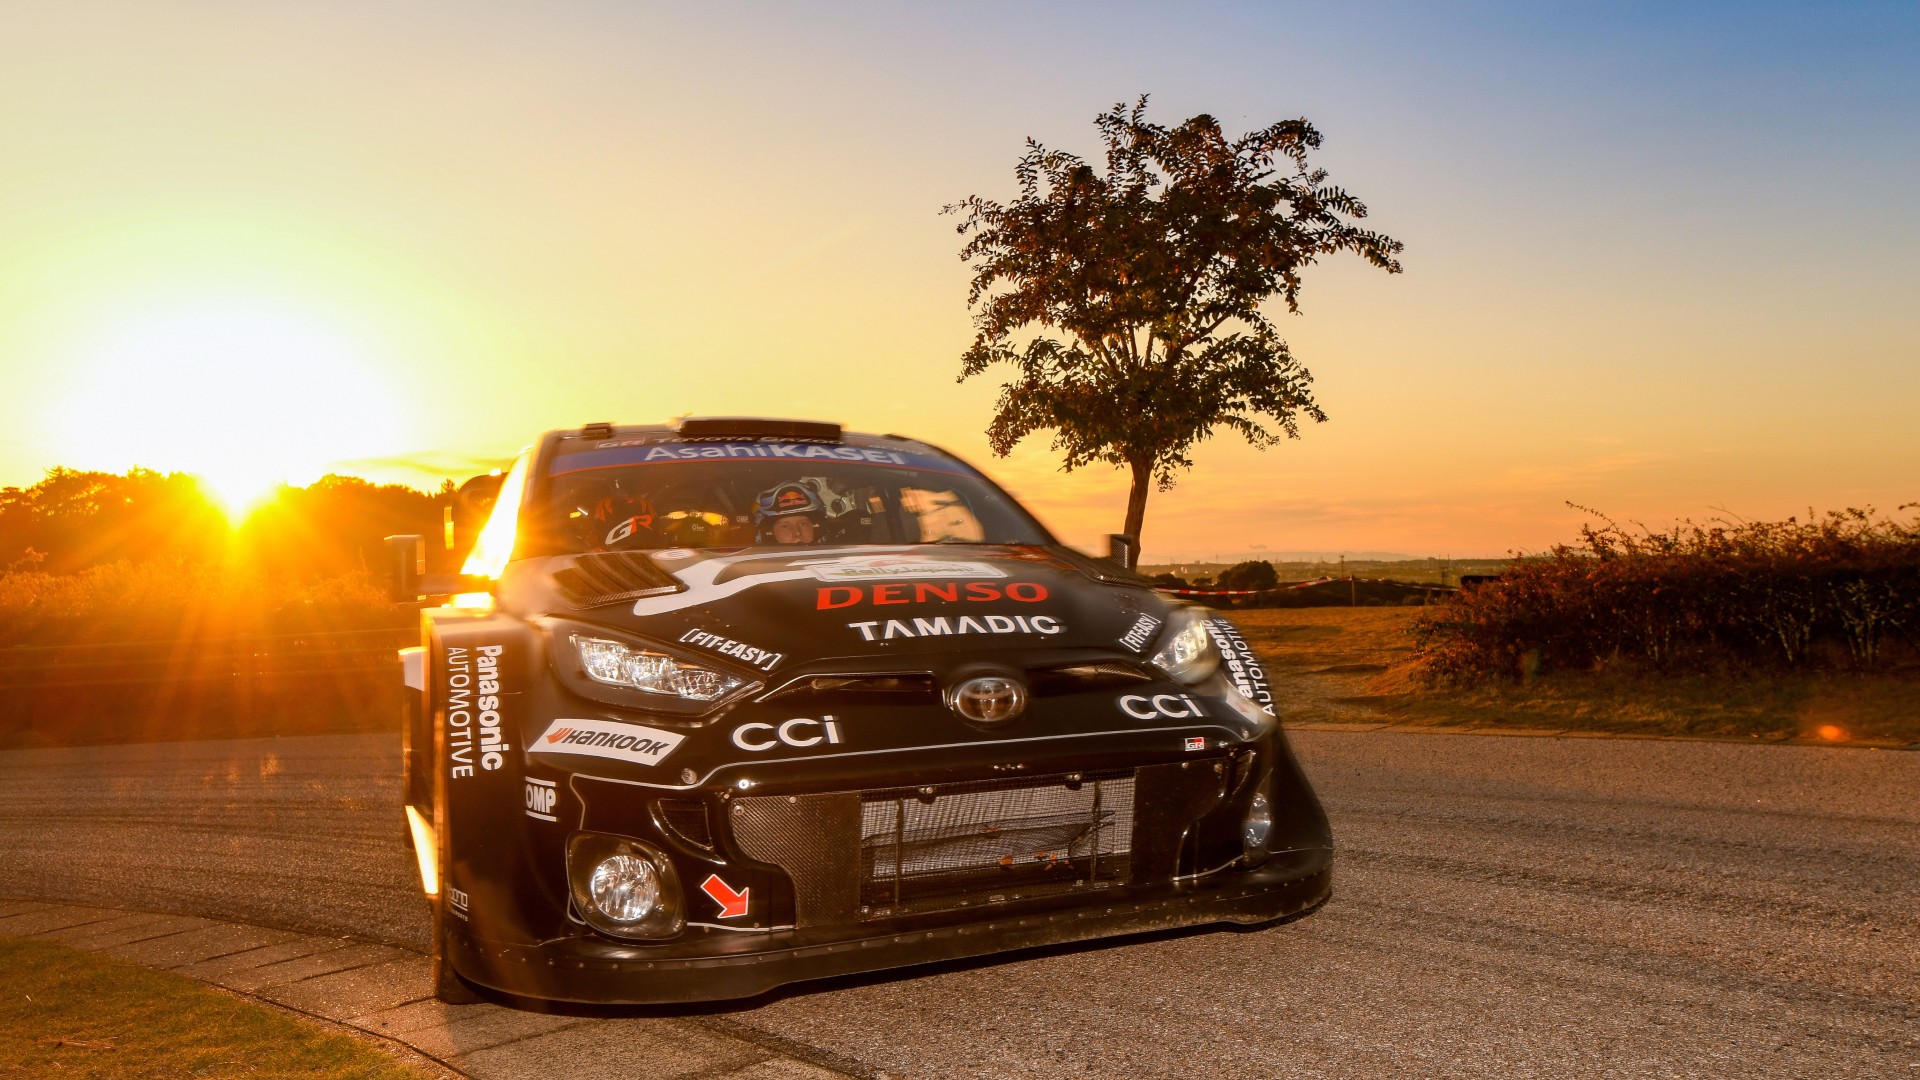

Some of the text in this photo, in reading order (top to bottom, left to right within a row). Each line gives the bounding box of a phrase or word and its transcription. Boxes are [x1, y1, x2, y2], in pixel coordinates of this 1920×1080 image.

[653, 436, 753, 444] TOYOTA
[605, 514, 653, 545] GR
[816, 582, 1048, 610] DENSO
[848, 615, 1061, 641] TAMADIC
[1213, 618, 1276, 717] AUTOMOTIVE
[448, 647, 473, 779] AUTOMOTIVE
[476, 645, 509, 770] Panasonic
[526, 784, 556, 814] OMP
